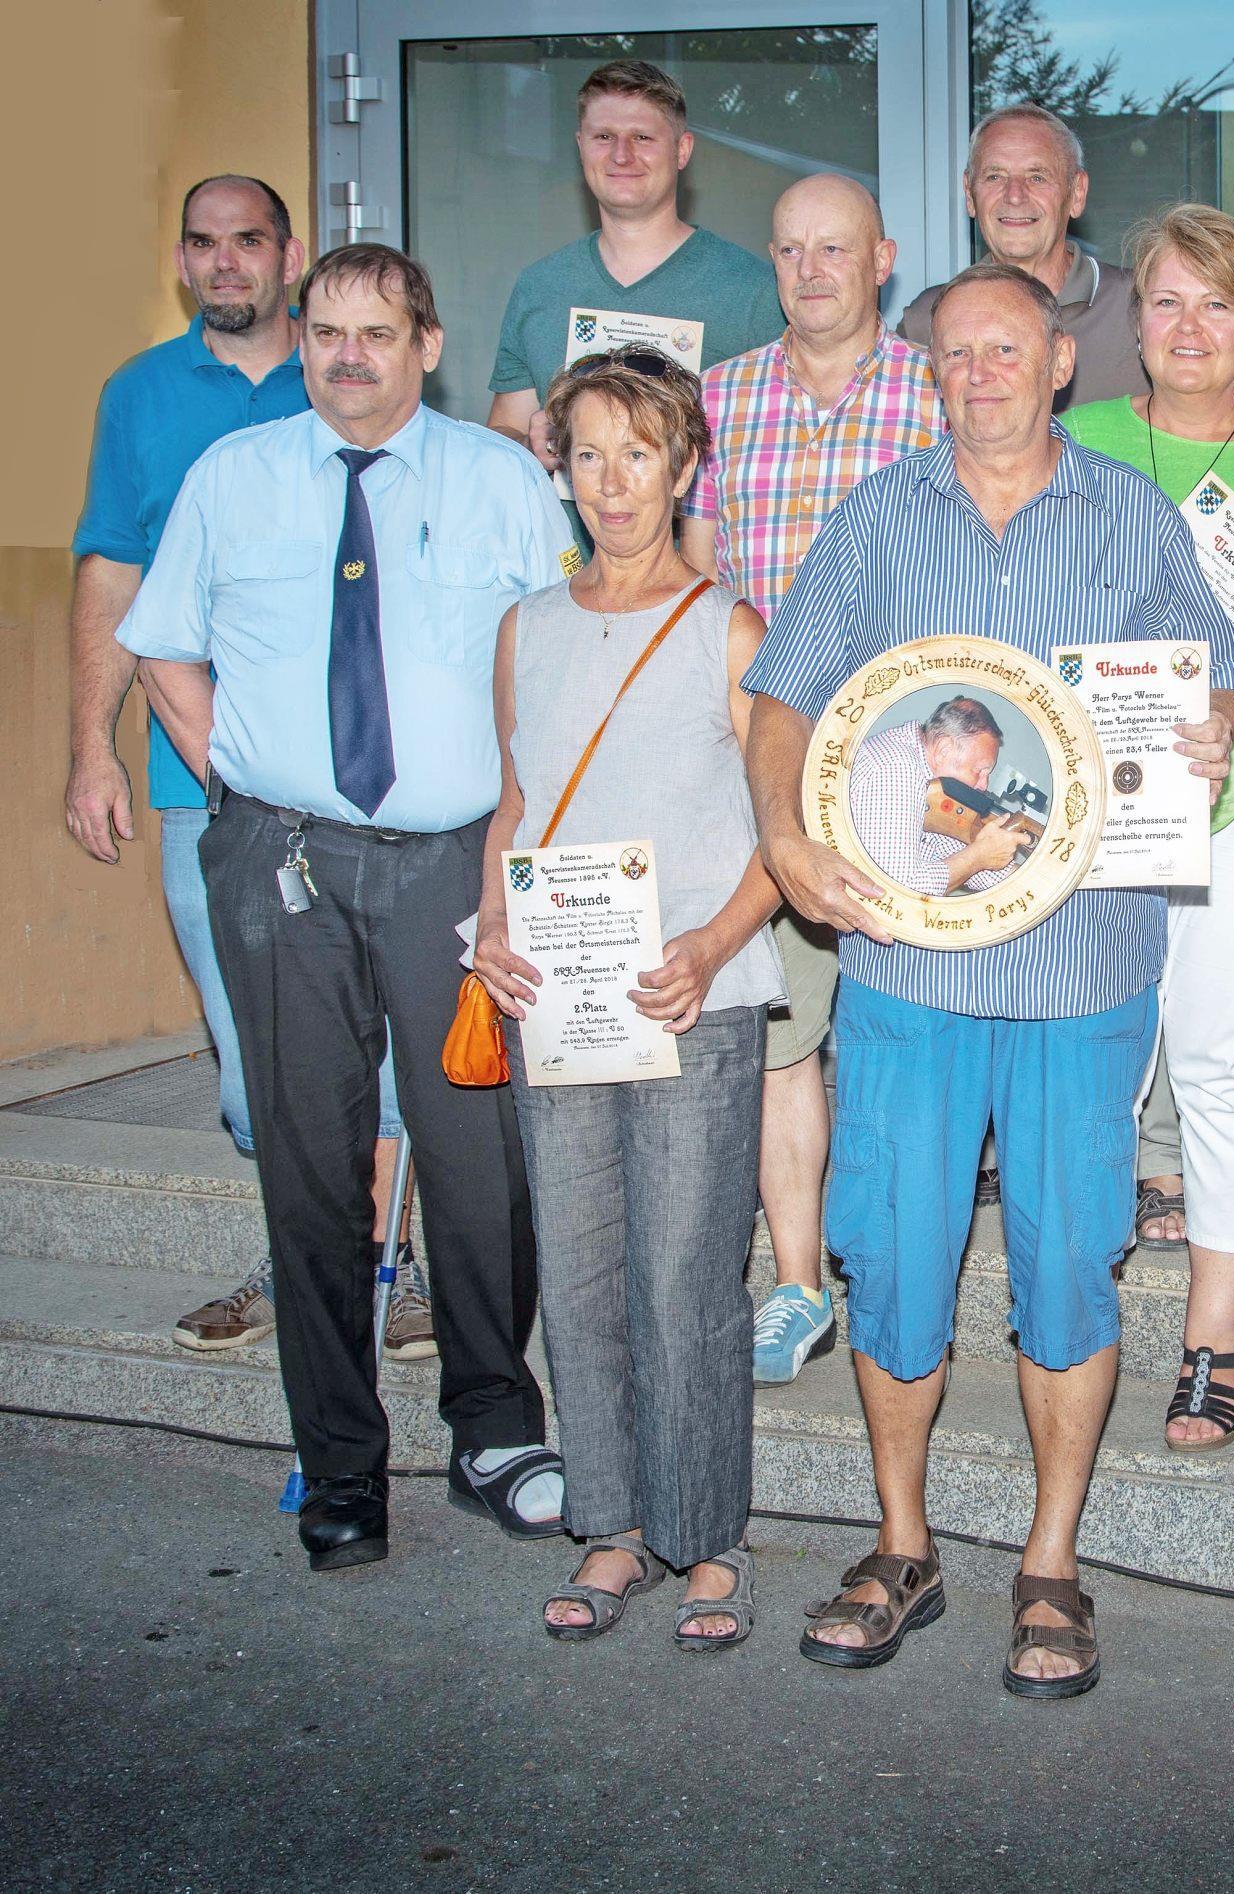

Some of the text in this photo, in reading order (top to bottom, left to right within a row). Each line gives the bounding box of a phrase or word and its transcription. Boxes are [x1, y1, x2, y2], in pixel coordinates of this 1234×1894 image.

[1096, 662, 1157, 677] Urkunde
[1092, 691, 1164, 702] Herr Parys Werner
[835, 698, 865, 723] 20
[1115, 716, 1157, 725] Luftgewehr
[1145, 744, 1168, 752] Teiler
[818, 739, 844, 852] SRK-Neuense
[1125, 817, 1168, 827] geschossen
[1145, 832, 1183, 840] errungen.
[1049, 837, 1075, 862] 18
[560, 854, 586, 862] Soldaten
[540, 863, 615, 875] Reservistenkameradschaft
[548, 876, 576, 885] Neuensee
[598, 872, 610, 880] e.V.
[551, 893, 611, 908] Urkunde
[923, 910, 973, 930] Werner
[985, 890, 1034, 922] Parys
[579, 938, 640, 948] Ortsmeisterschaft
[554, 963, 628, 977] SRK-Neuensee e.V.
[574, 1002, 607, 1014] 2.Platz
